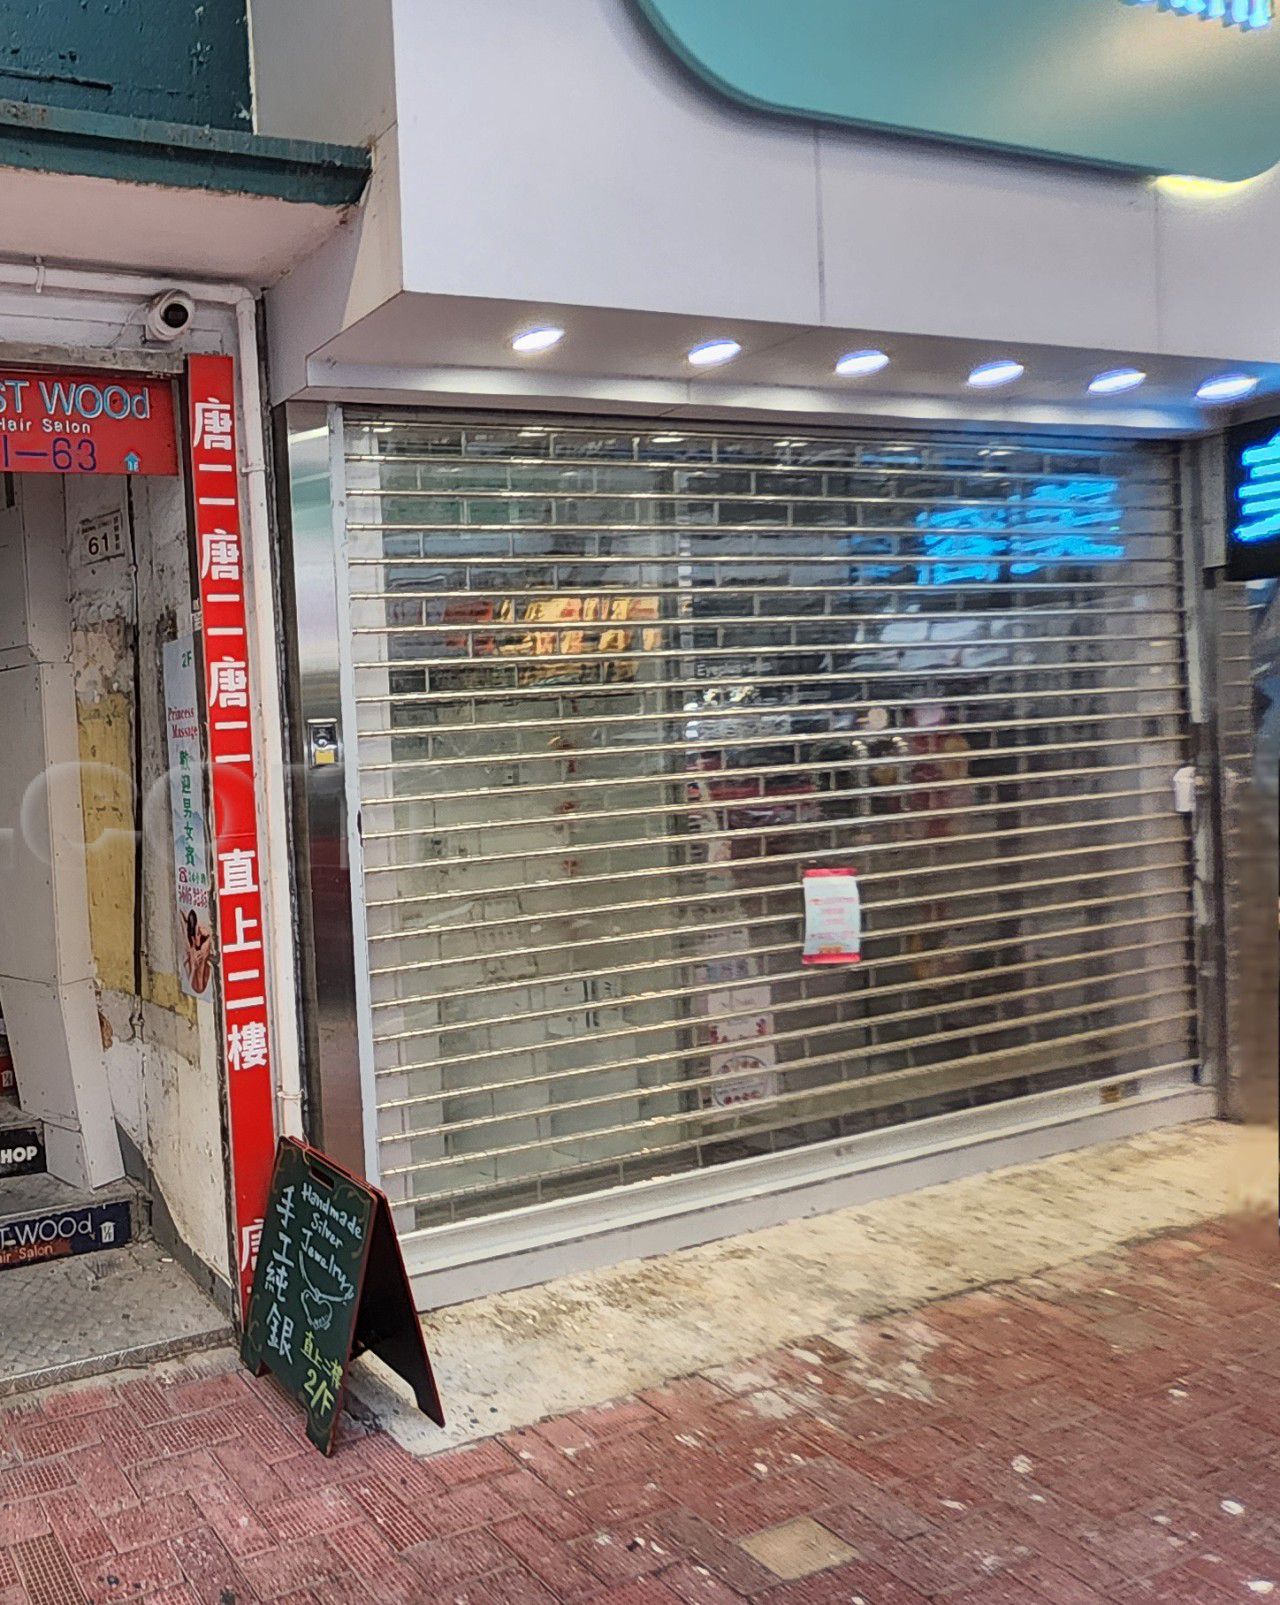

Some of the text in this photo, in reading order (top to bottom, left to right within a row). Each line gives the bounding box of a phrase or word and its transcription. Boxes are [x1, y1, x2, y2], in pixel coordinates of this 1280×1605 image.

[39, 381, 150, 420] WOOd
[42, 418, 91, 434] Salon
[87, 532, 109, 556] 61
[168, 706, 195, 722] Princess
[172, 724, 198, 740] Massage
[217, 848, 269, 1072] 直上二樓
[301, 1182, 363, 1240] Handmade
[311, 1212, 343, 1249] Silver
[18, 1244, 54, 1261] Salon
[265, 1185, 296, 1366] 手工純銀
